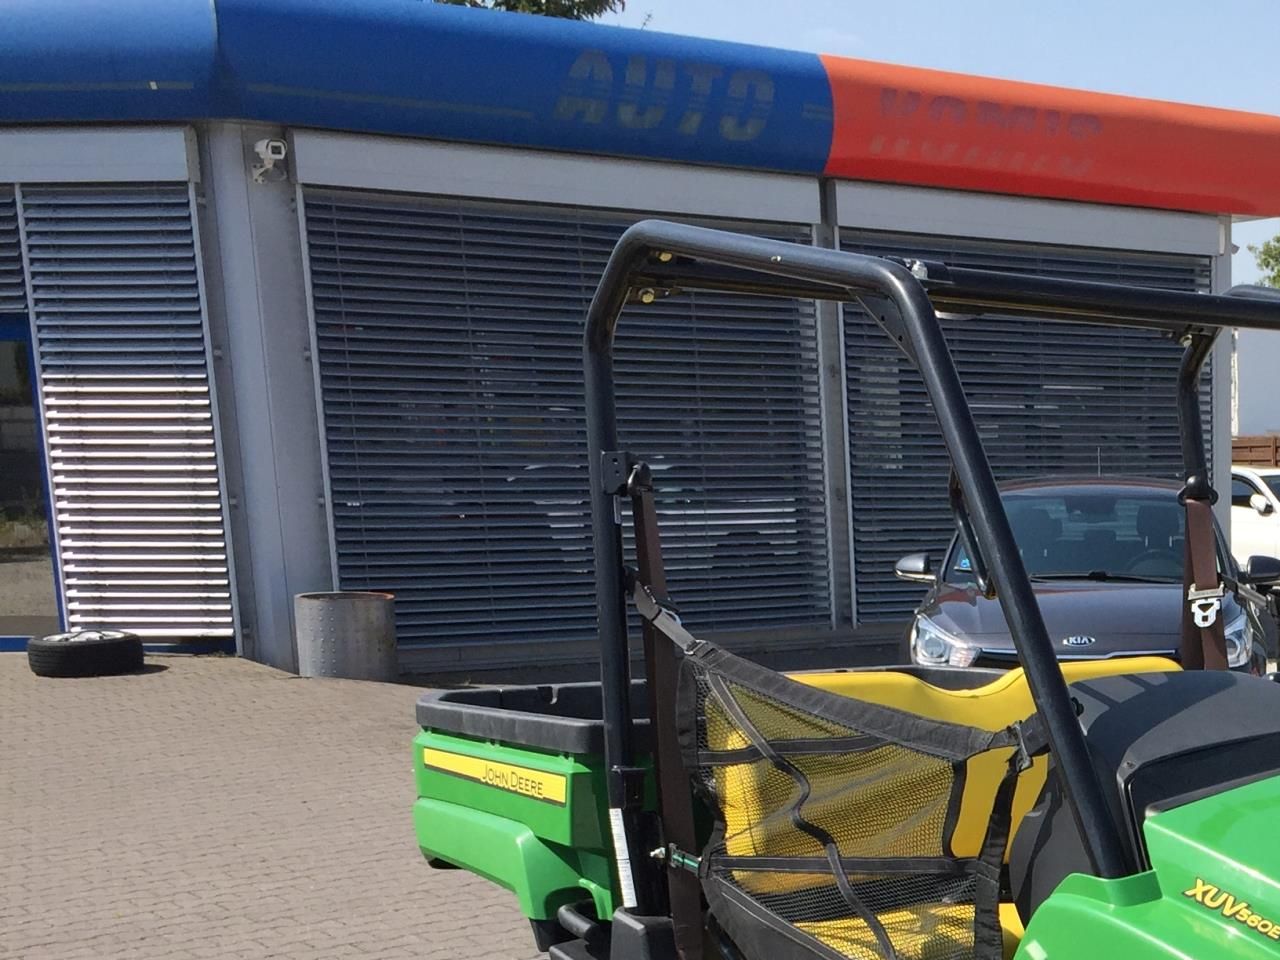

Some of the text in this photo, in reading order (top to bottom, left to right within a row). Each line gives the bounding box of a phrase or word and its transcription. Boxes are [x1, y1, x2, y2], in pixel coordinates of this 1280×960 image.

[555, 48, 775, 142] AUTO
[1069, 636, 1089, 644] KIA
[482, 764, 543, 796] JOHN DEERE
